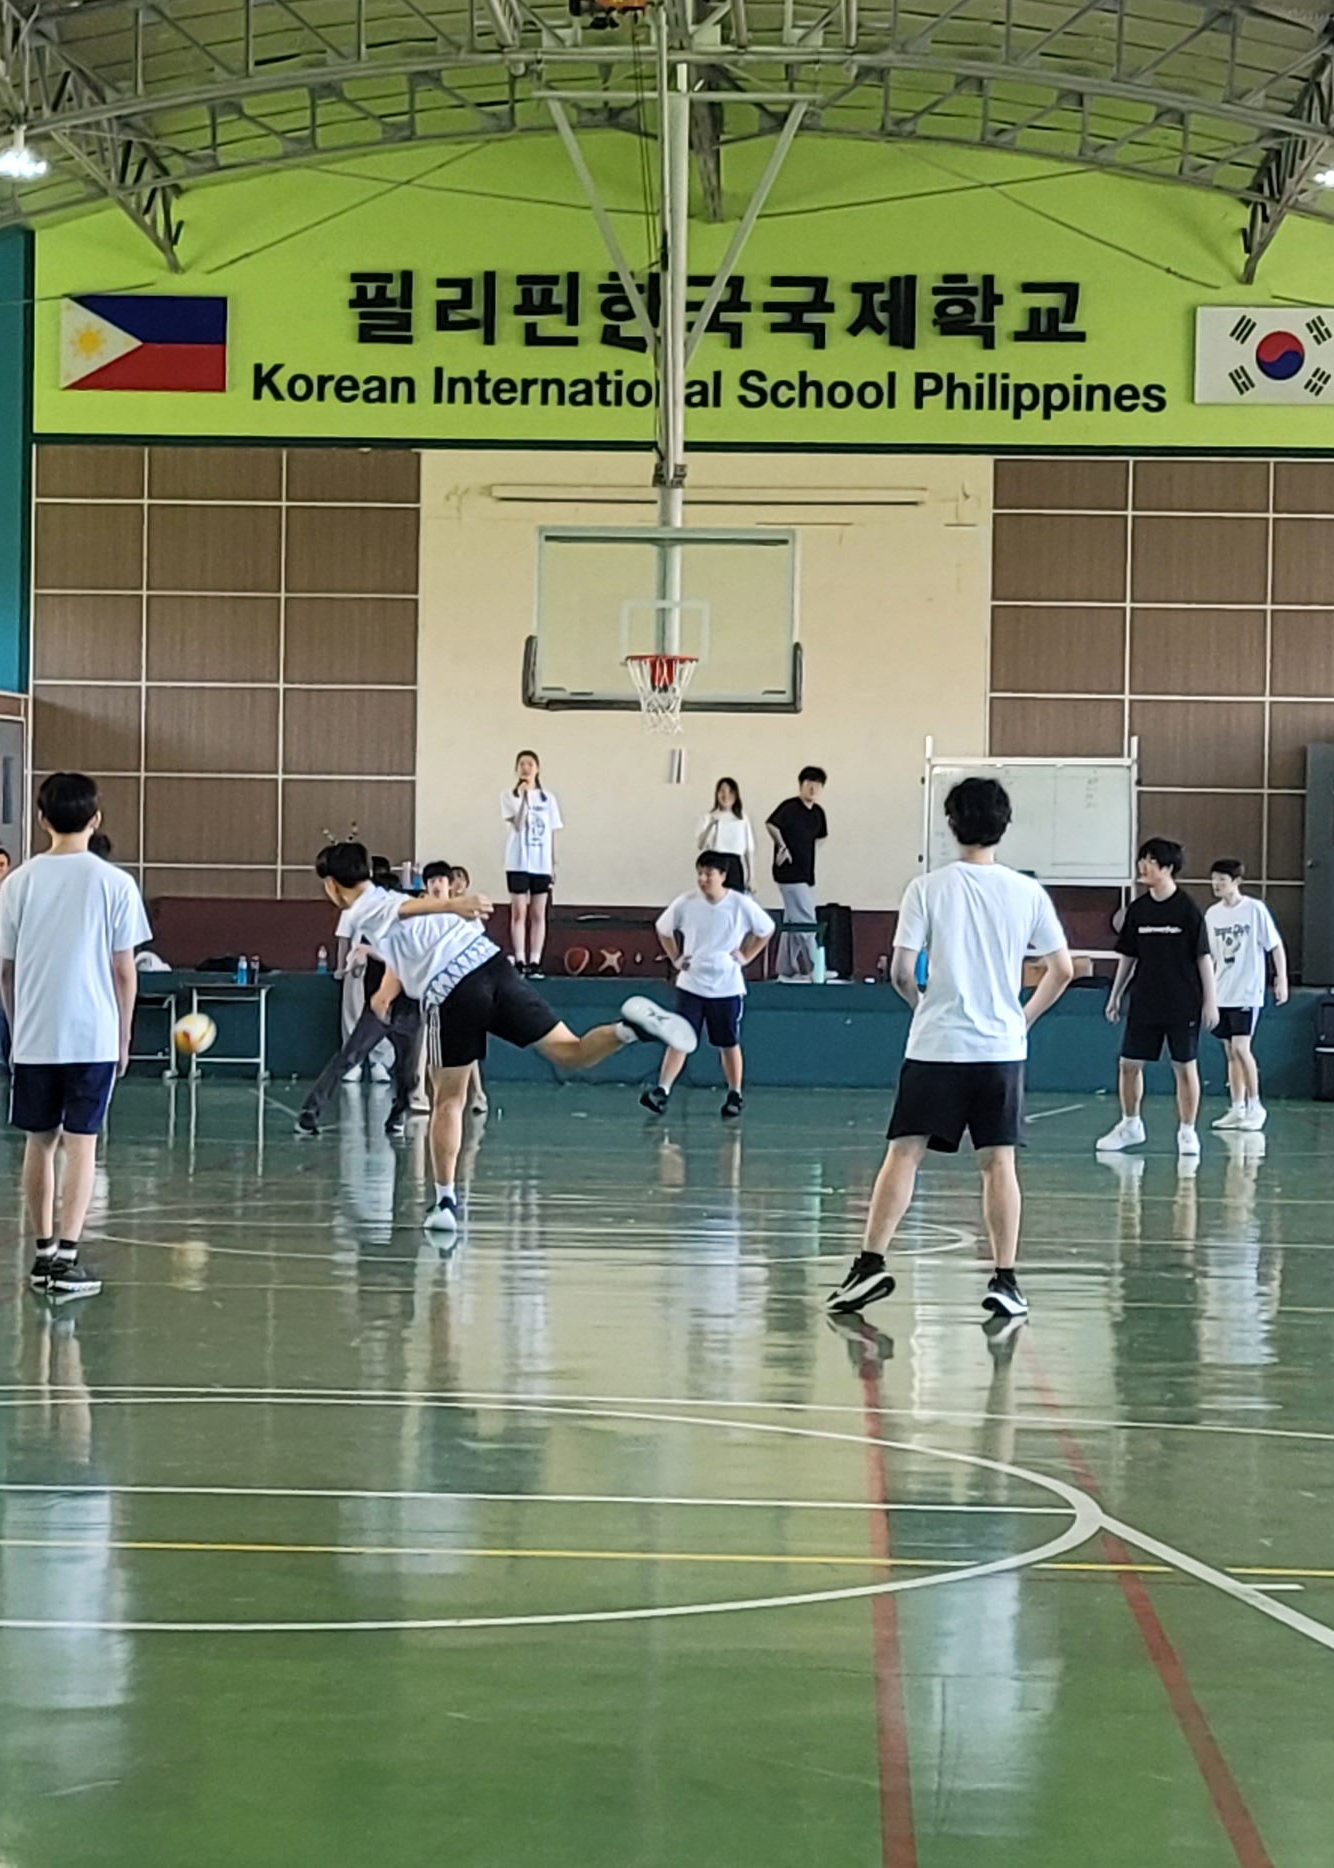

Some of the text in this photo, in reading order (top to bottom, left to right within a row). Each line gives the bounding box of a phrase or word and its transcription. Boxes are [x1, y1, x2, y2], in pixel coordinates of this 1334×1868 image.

[348, 269, 1087, 353] 필리핀한국국제학교
[252, 362, 1168, 420] Korean Internatioal School Philippines
